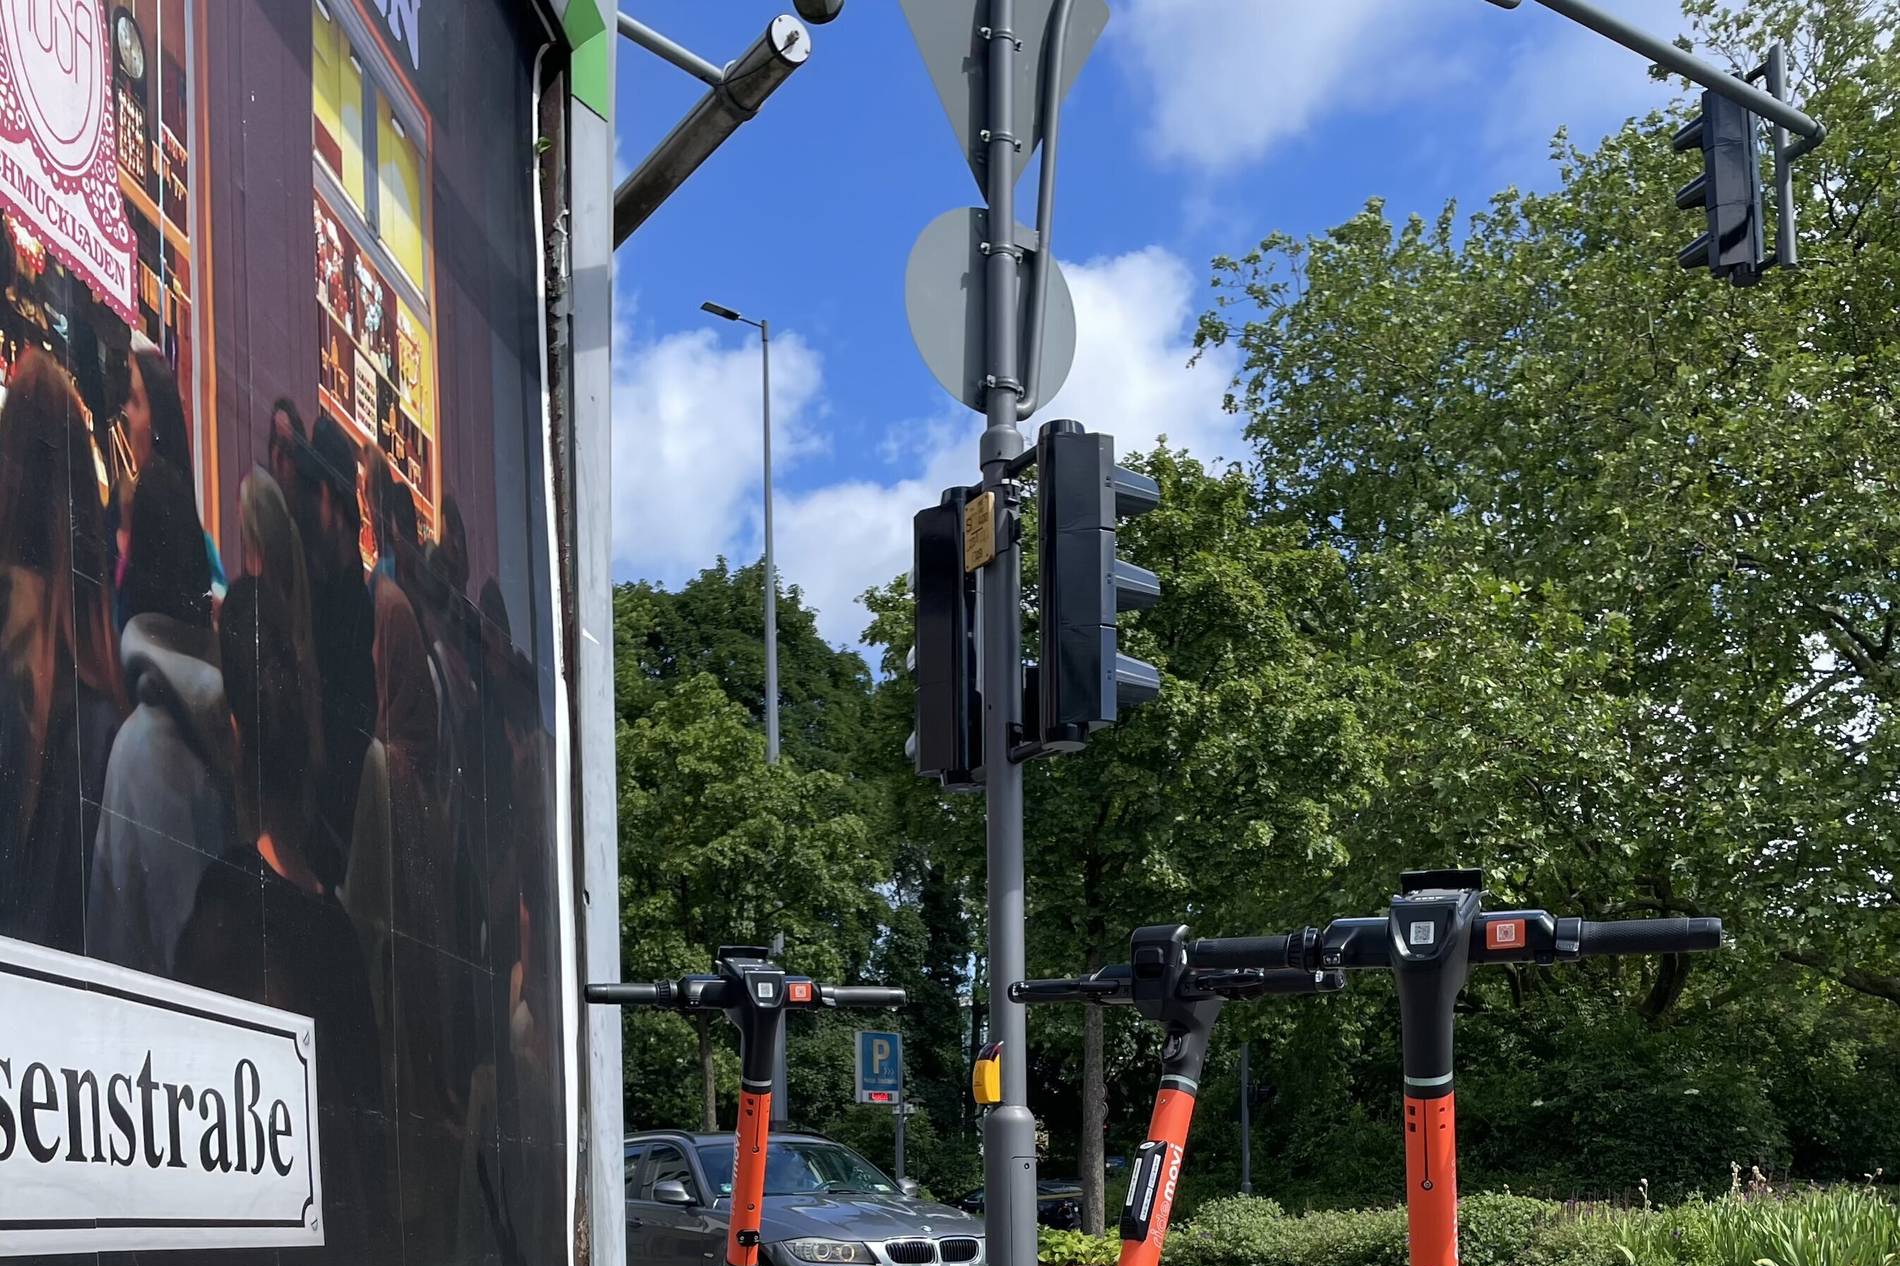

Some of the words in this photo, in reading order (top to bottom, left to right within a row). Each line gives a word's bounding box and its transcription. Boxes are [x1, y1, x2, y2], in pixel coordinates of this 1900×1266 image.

[0, 153, 125, 290] HMUCKLADEN
[872, 1039, 890, 1074] P
[1153, 1143, 1184, 1248] ridemovi
